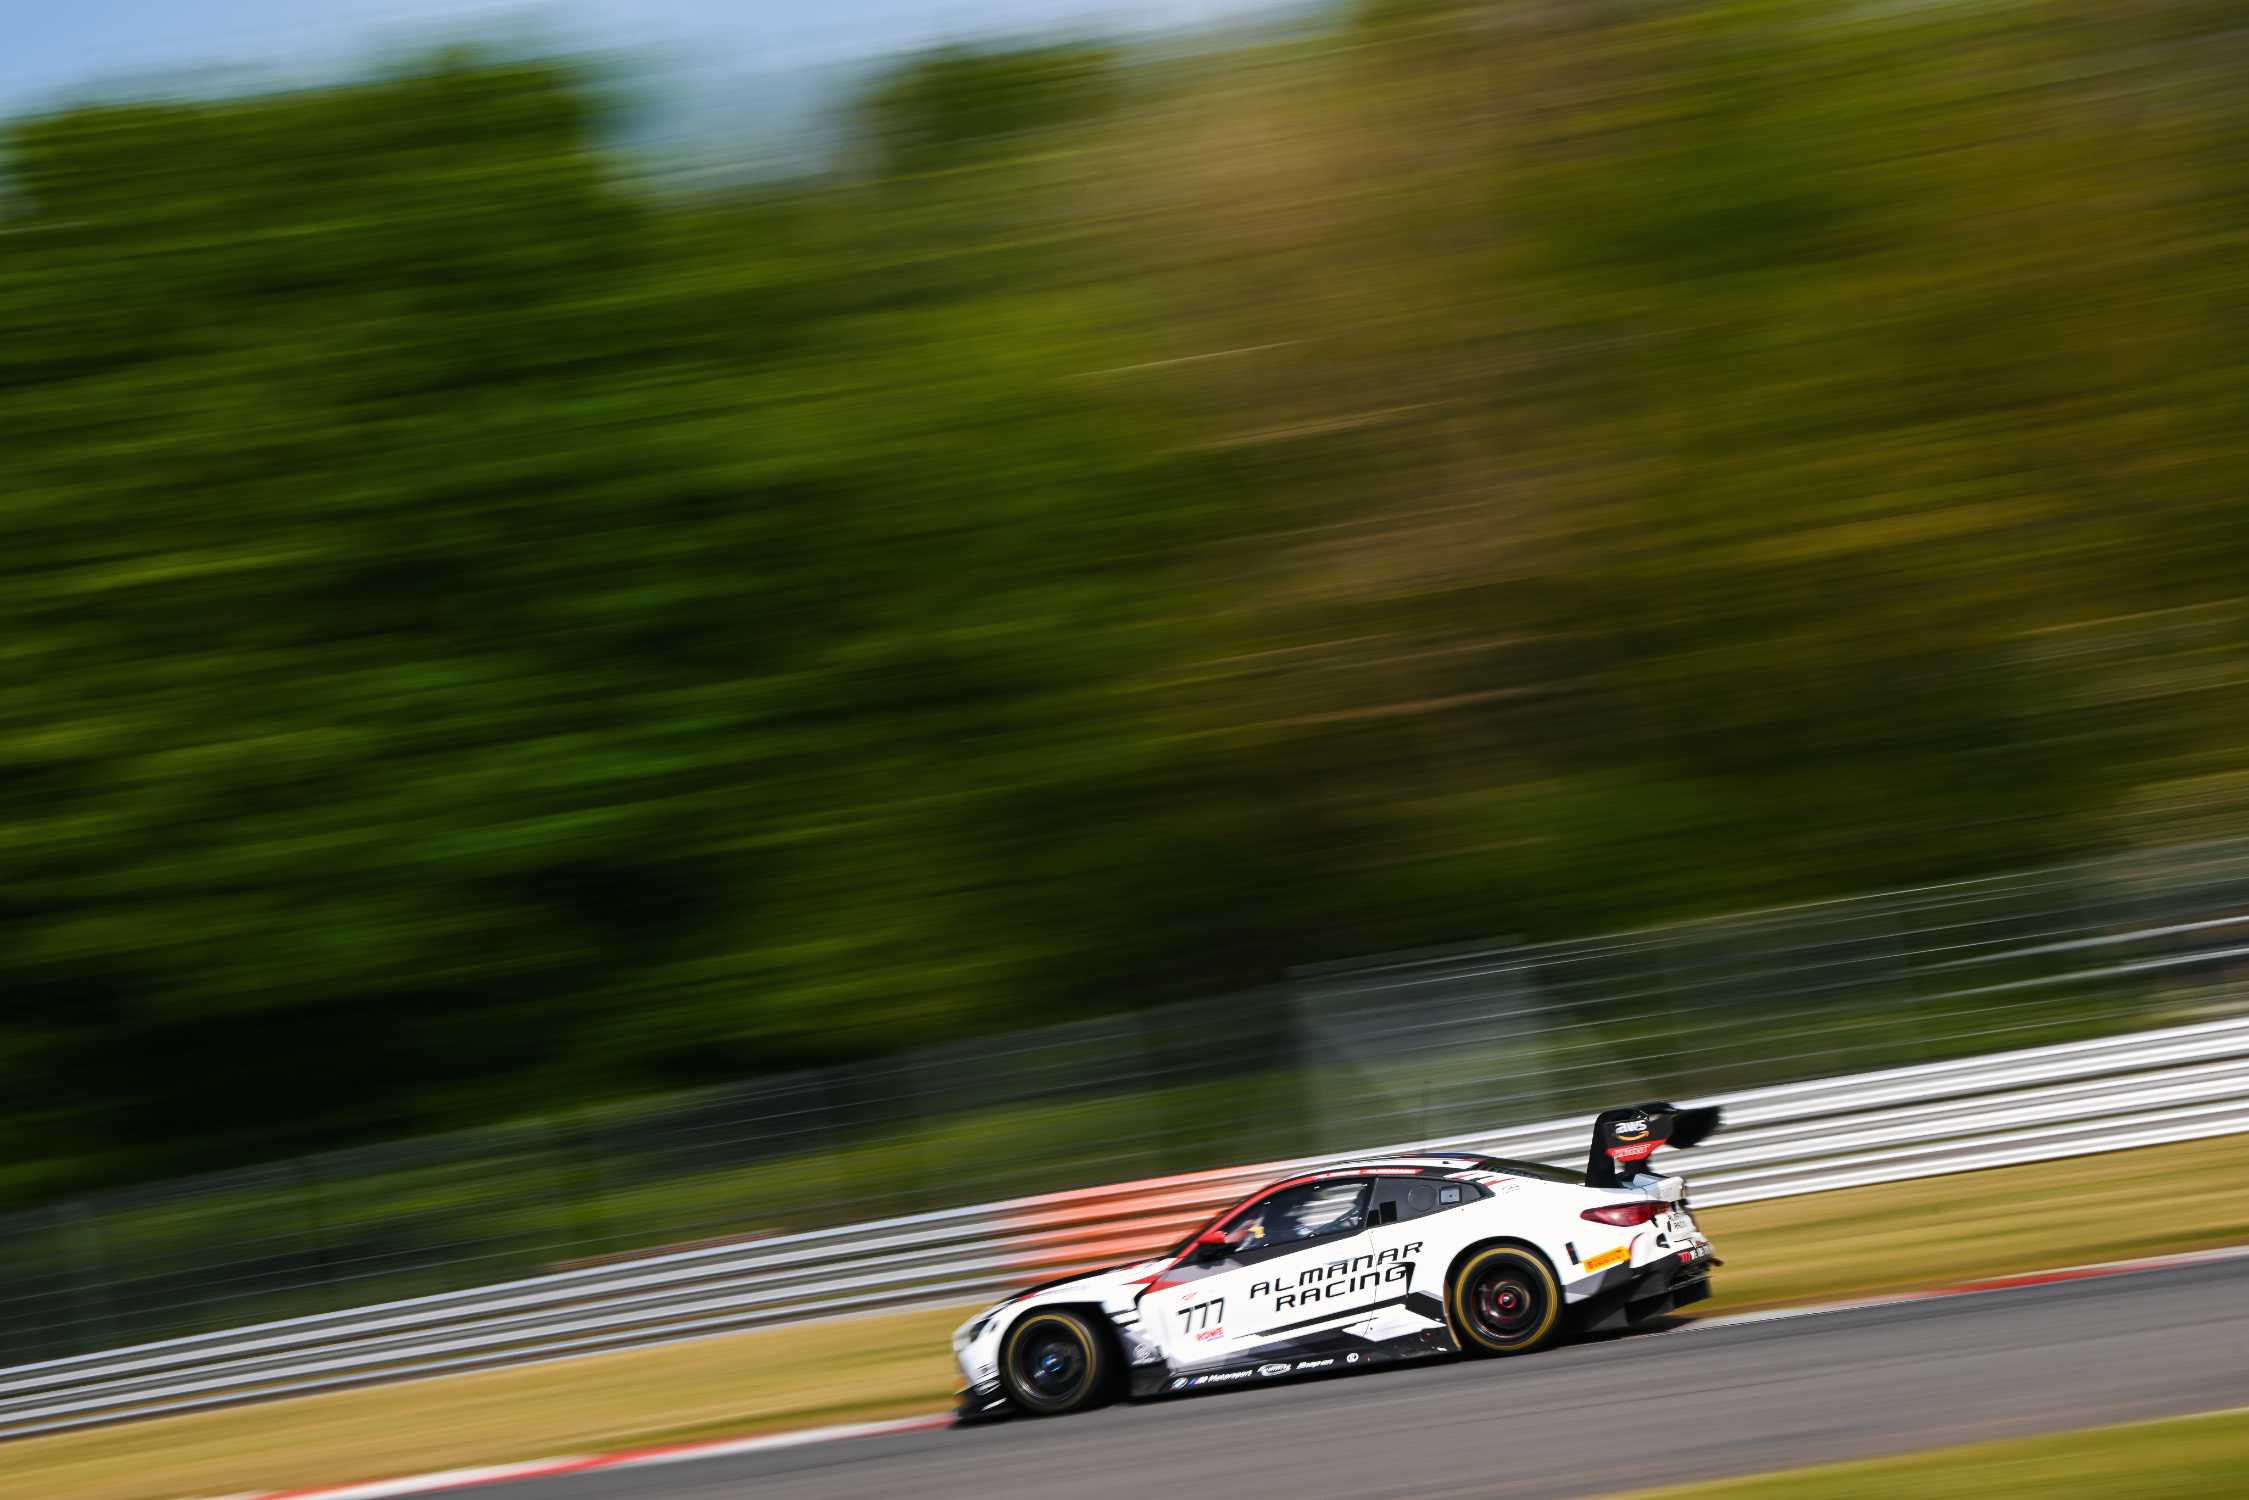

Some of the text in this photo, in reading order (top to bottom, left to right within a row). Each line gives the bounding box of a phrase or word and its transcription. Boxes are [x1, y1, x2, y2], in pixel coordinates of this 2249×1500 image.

[1615, 1119, 1648, 1134] aws
[1250, 1241, 1424, 1299] ALMANAR
[1275, 1265, 1408, 1312] RACING
[1177, 1297, 1225, 1334] 777
